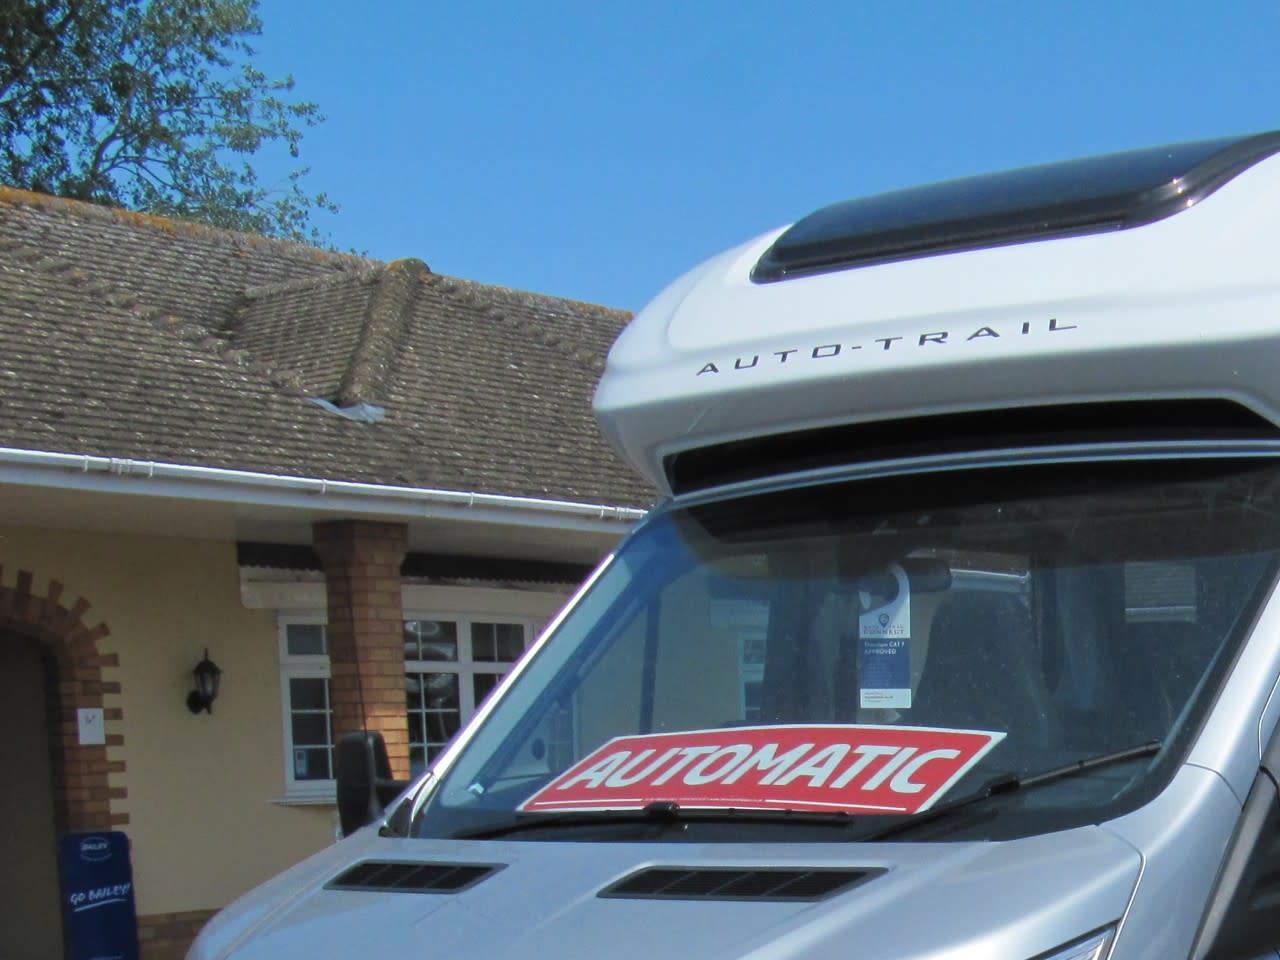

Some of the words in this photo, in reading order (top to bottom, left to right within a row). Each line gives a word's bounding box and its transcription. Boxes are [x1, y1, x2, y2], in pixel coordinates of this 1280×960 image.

[696, 317, 1078, 376] AUTO-TRAIL
[557, 743, 961, 793] AUTOMATIC
[70, 892, 87, 905] GO
